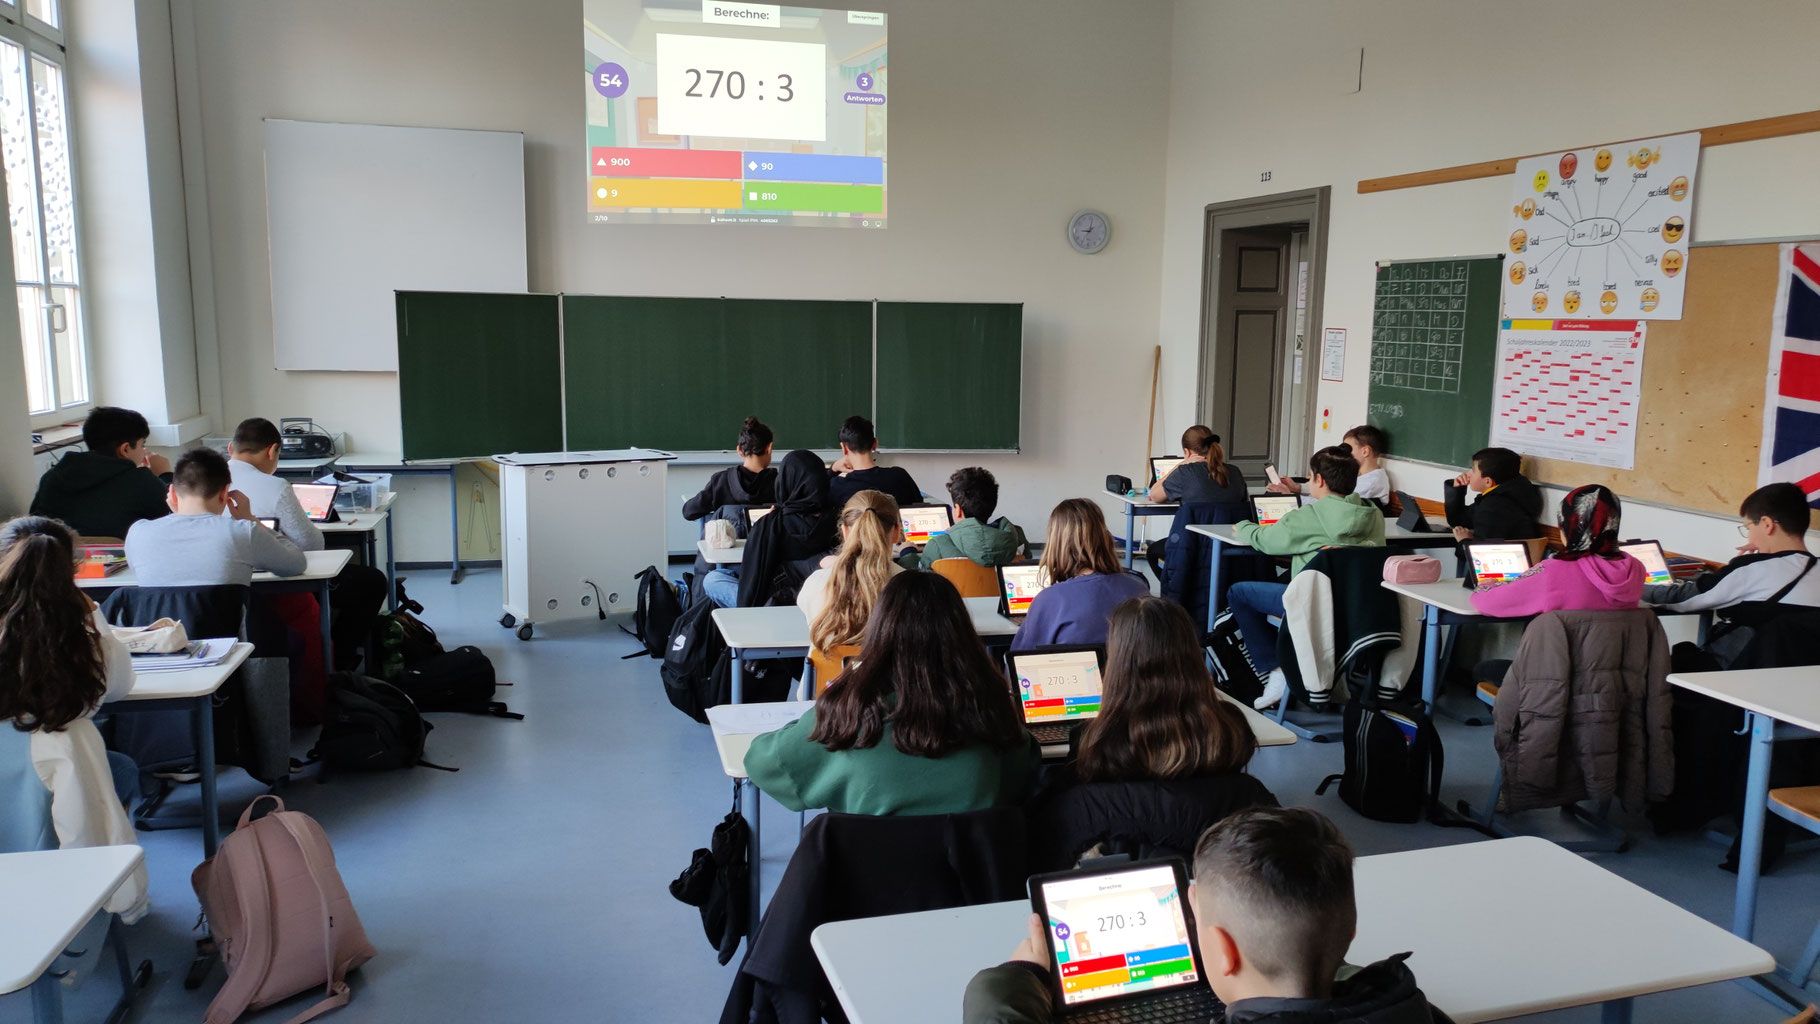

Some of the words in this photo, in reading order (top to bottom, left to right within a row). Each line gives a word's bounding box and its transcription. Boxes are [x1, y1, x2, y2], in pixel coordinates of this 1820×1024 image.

[714, 7, 770, 20] Berechne:
[600, 73, 622, 87] 54
[685, 68, 745, 100] 270
[758, 80, 764, 101] :
[777, 74, 794, 102] 3
[861, 77, 869, 87] 3
[846, 94, 883, 103] Antworten
[611, 157, 631, 167] 900
[761, 163, 774, 171] 90
[1260, 171, 1272, 183] 113
[611, 189, 618, 198] 9
[761, 192, 778, 201] 810
[1559, 339, 1592, 348] 2022/2023
[1048, 676, 1065, 686] 270
[1072, 675, 1079, 684] 3
[1097, 914, 1125, 932] 270
[1137, 911, 1147, 926] 3
[1057, 927, 1068, 936] 54
